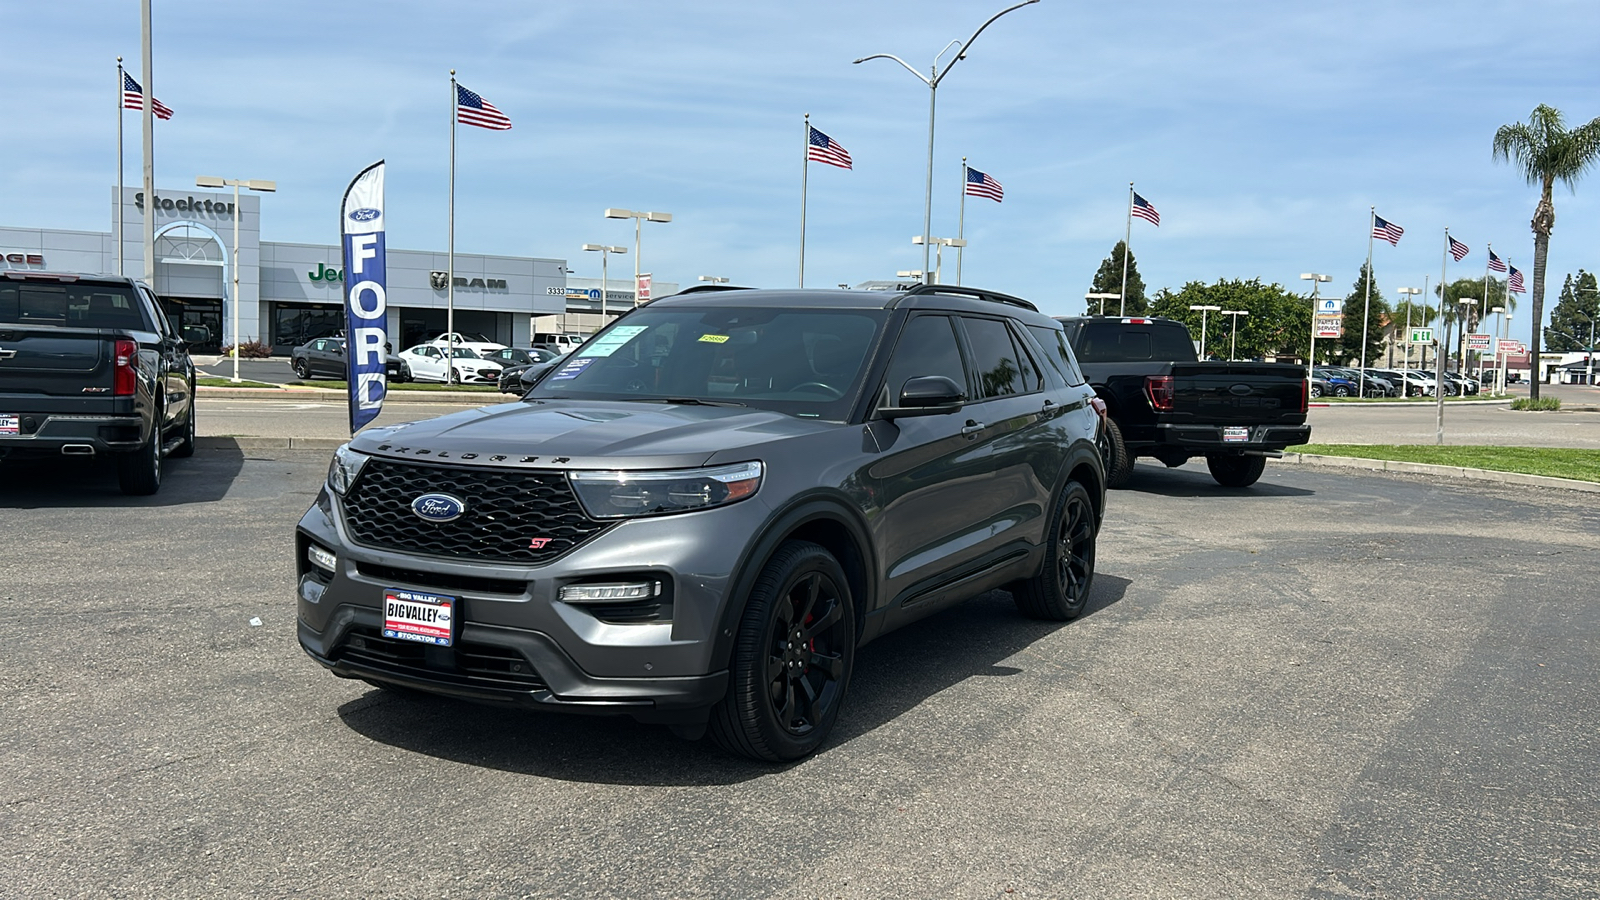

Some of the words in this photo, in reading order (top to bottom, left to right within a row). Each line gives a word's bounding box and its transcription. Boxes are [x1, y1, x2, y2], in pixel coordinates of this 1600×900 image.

[0, 253, 42, 265] GE
[452, 277, 507, 289] RAM
[547, 287, 565, 295] 3333
[605, 292, 634, 300] Service
[350, 233, 387, 411] FORD
[377, 444, 571, 464] EXPLORER
[421, 498, 451, 517] Ford
[528, 537, 553, 549] ST
[399, 592, 412, 600] BIG
[412, 594, 438, 603] VALLEY
[387, 602, 439, 623] BIGVALLEY
[397, 632, 436, 643] STOCKTON
